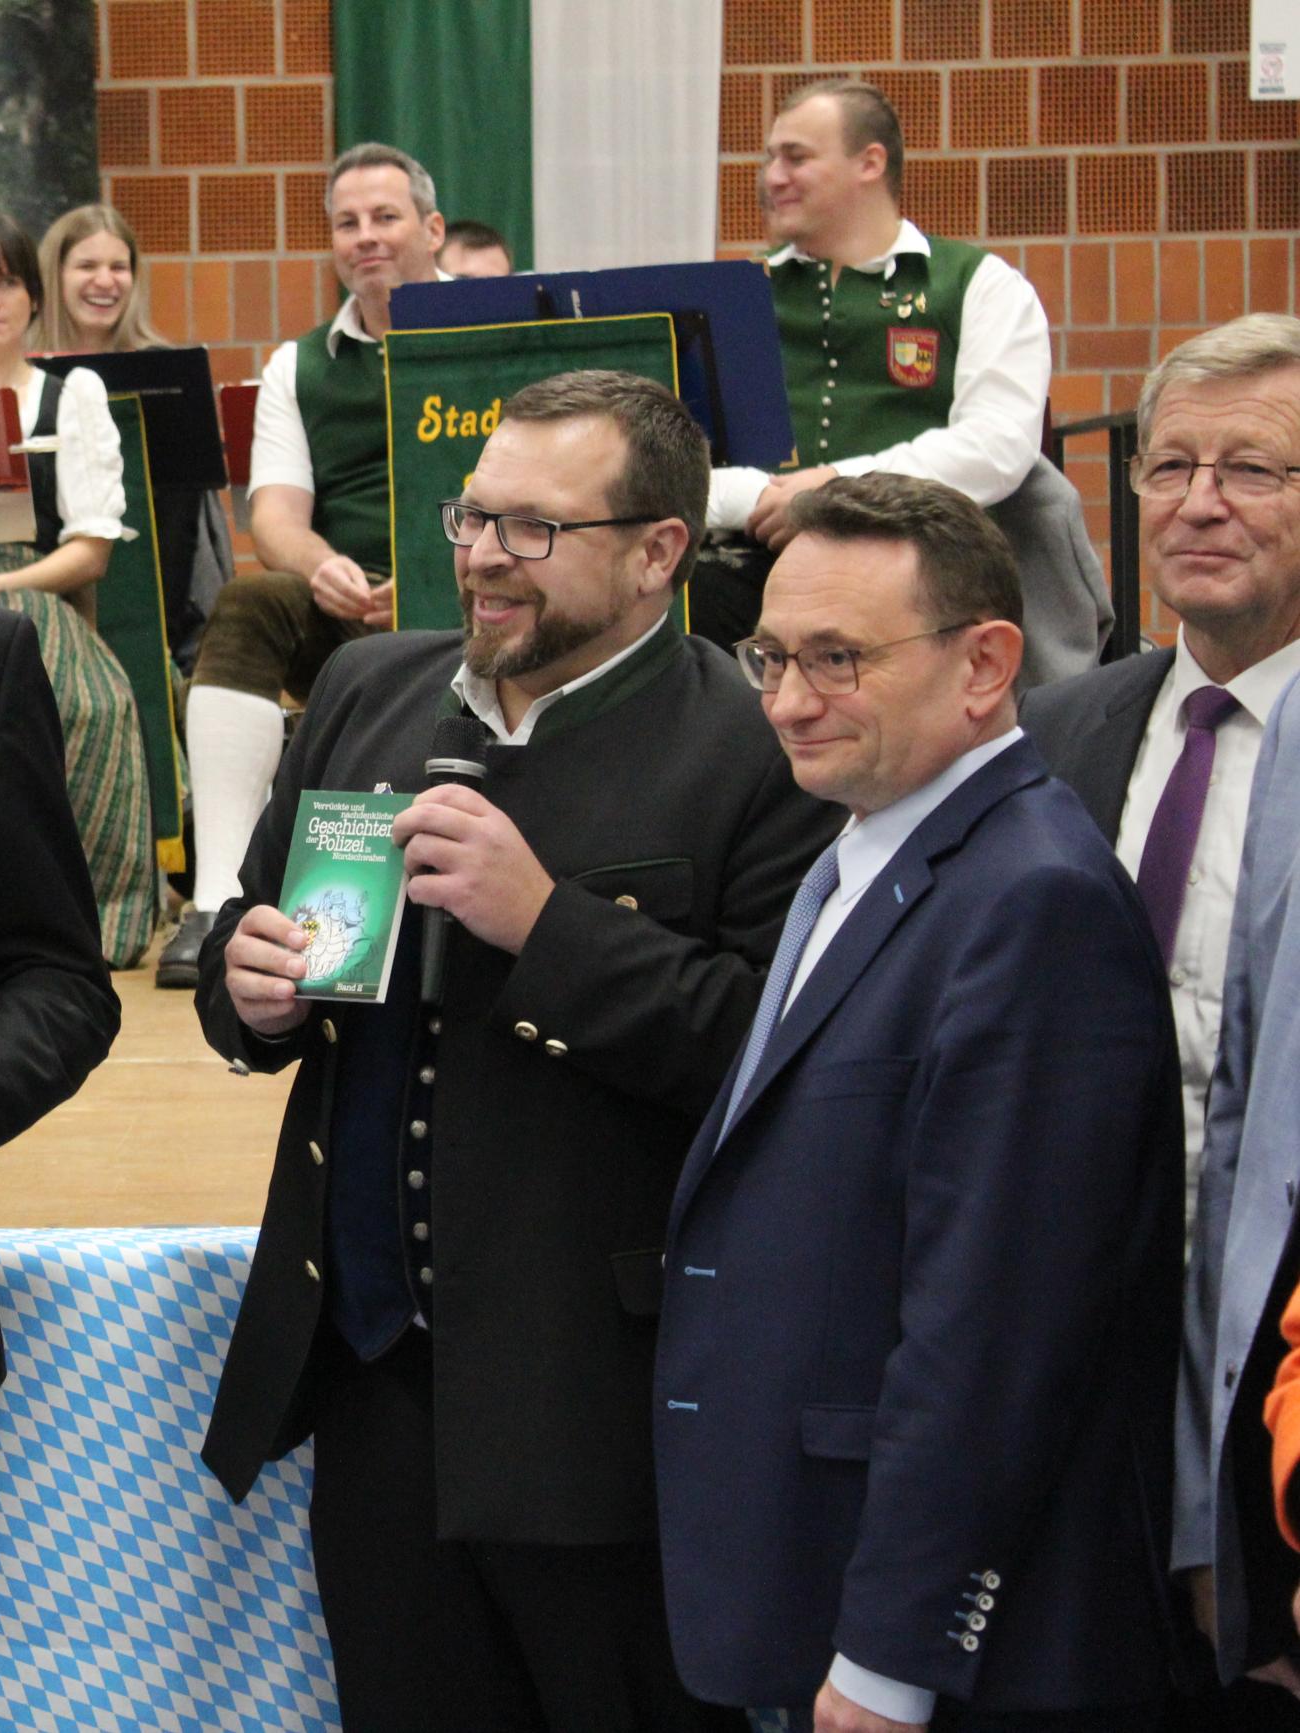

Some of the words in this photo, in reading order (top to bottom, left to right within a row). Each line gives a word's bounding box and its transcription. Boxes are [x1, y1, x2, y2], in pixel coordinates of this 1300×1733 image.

[417, 395, 501, 443] Stad
[350, 804, 365, 812] und
[306, 835, 319, 844] der
[316, 834, 365, 853] Polizei
